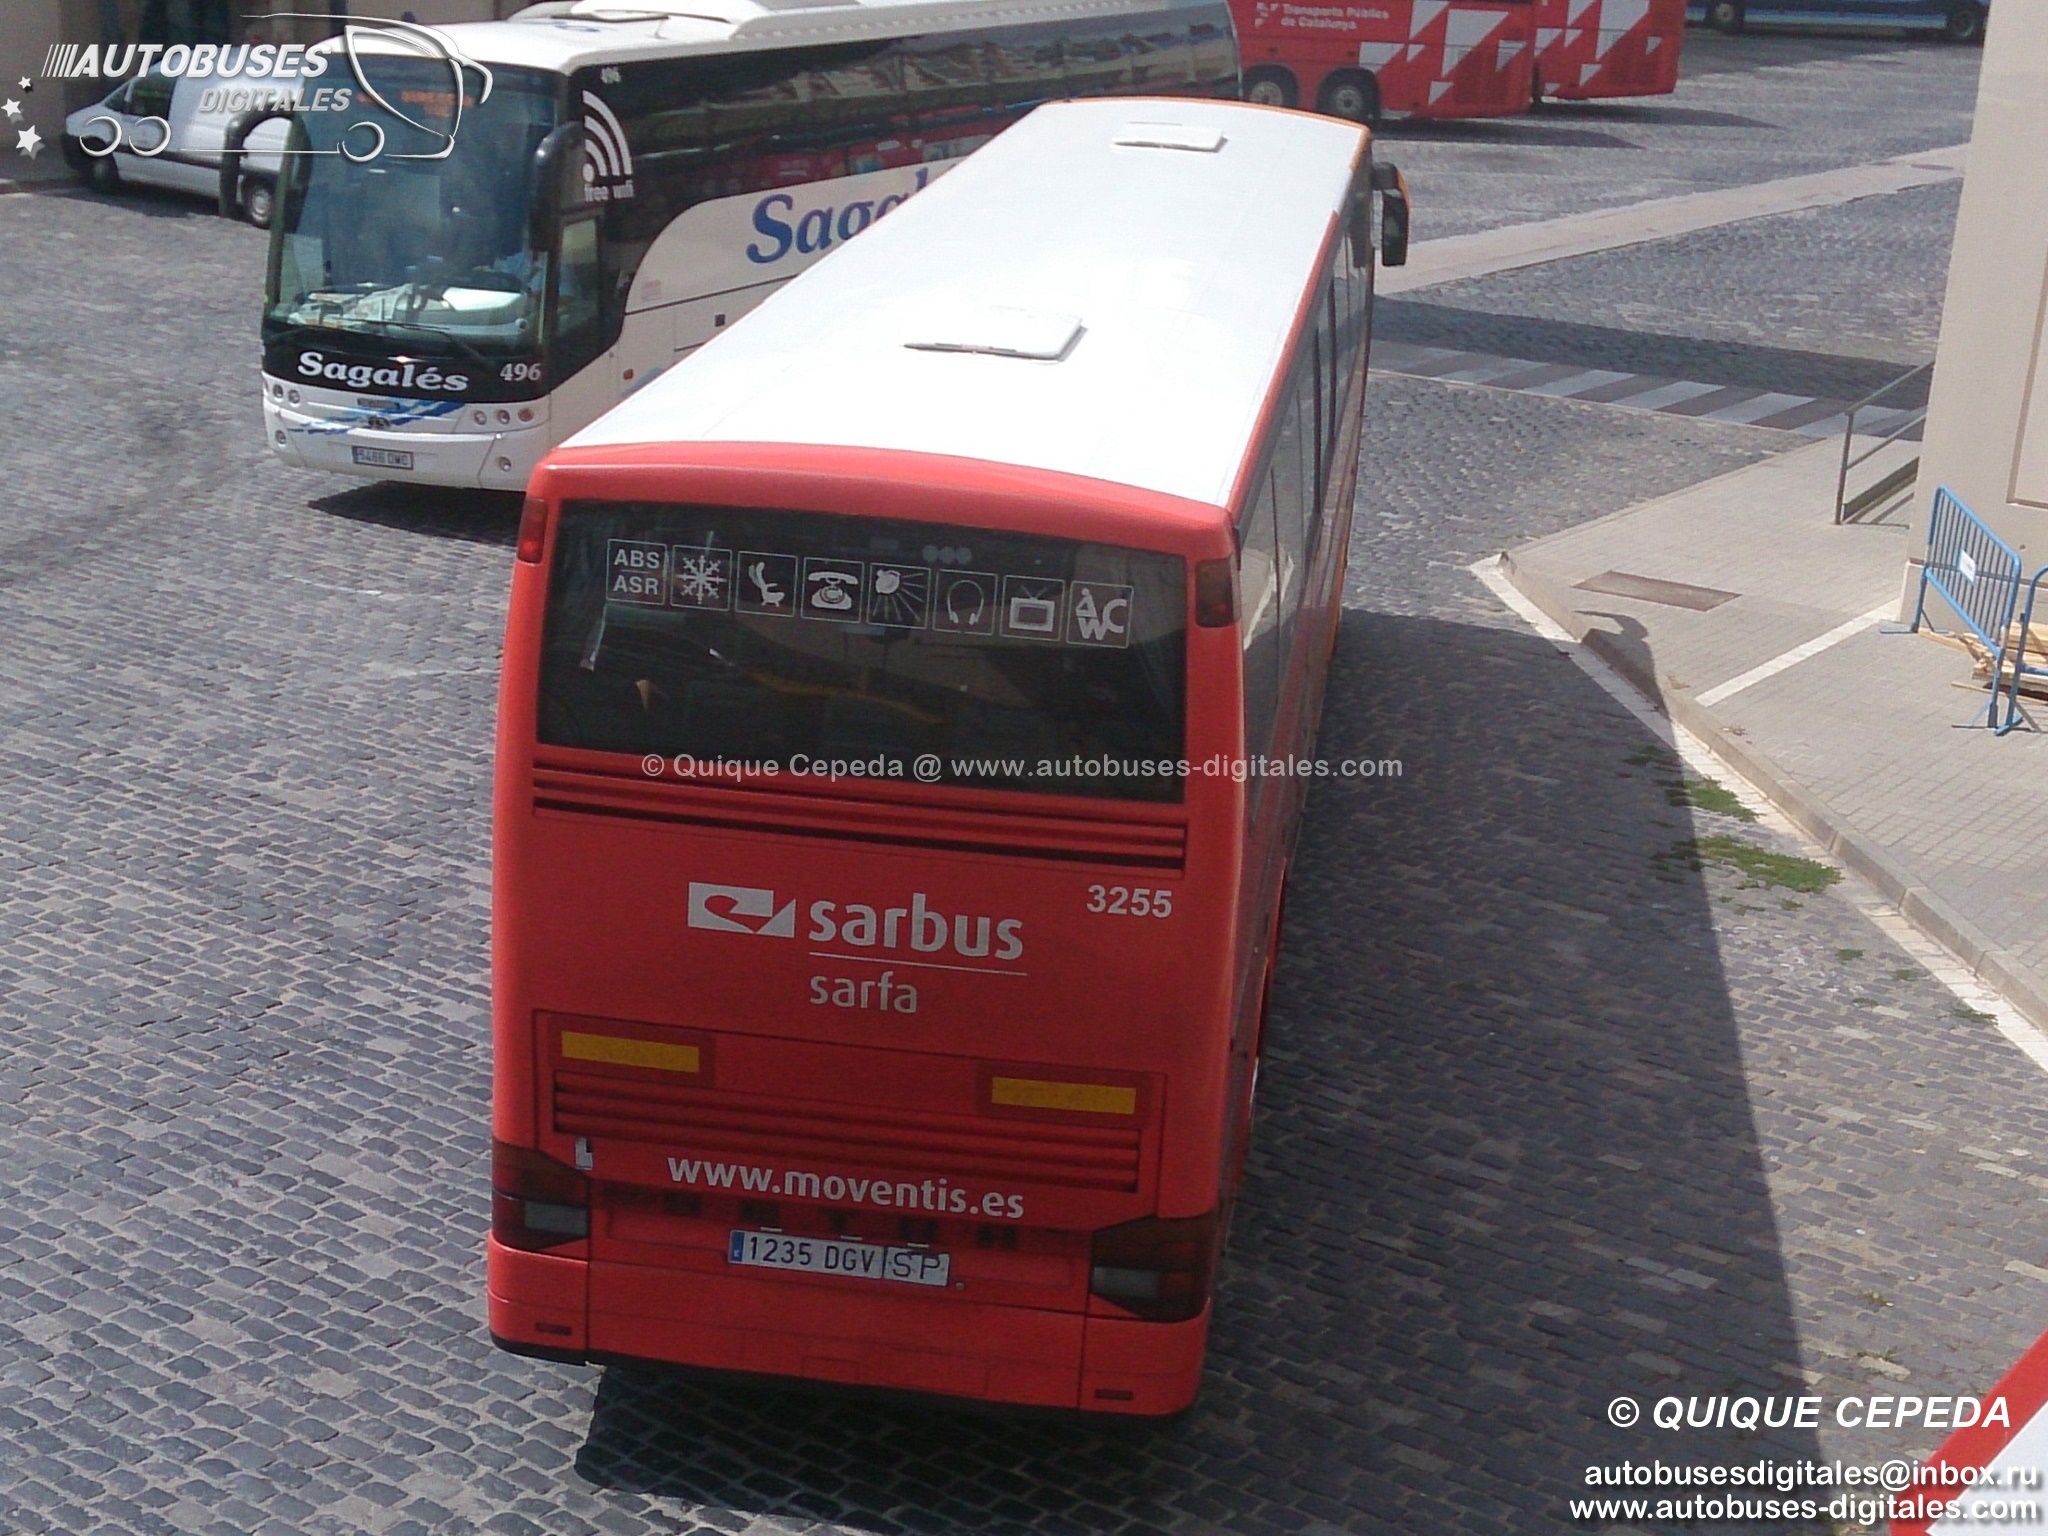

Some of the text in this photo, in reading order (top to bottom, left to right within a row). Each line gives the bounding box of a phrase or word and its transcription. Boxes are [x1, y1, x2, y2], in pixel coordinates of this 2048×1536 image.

[584, 183, 609, 202] free
[298, 351, 469, 391] Sagalés
[500, 363, 542, 381] 496
[613, 548, 660, 569] ABS
[613, 574, 658, 595] ASR
[1077, 598, 1127, 641] WC
[1086, 884, 1173, 919] 3255
[808, 892, 1025, 960] sarbus
[809, 970, 918, 1014] sarfa
[667, 1156, 1025, 1219] www.moventis.es
[750, 1235, 812, 1266] 1235
[823, 1245, 875, 1273] DGV
[892, 1251, 941, 1280] SP
